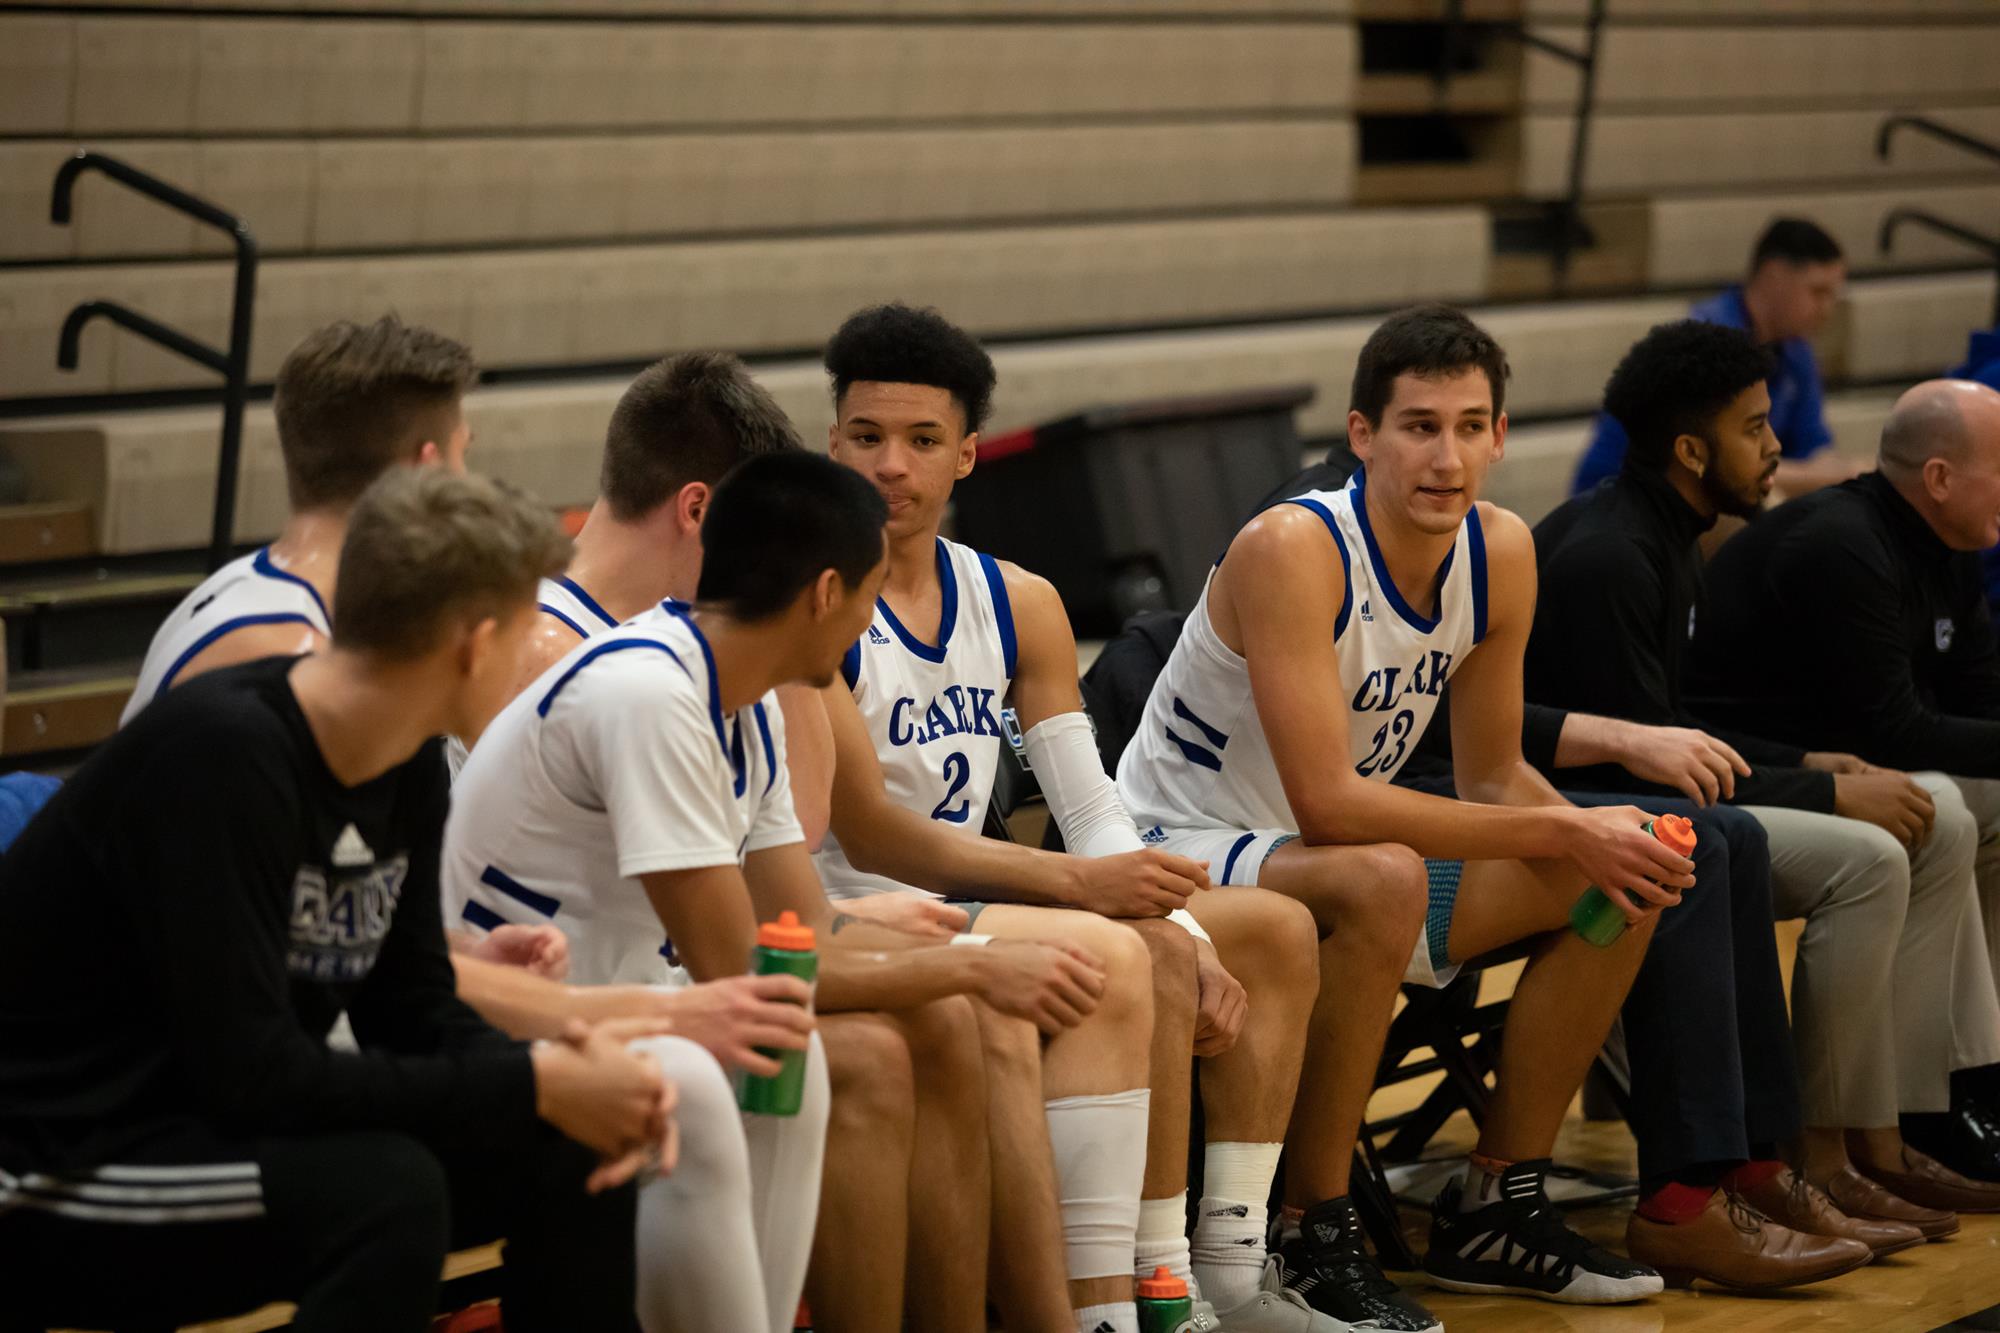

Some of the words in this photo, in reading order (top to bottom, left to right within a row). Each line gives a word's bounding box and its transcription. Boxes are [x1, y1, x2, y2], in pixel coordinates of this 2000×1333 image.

[1352, 650, 1452, 712] CLRK
[889, 684, 1000, 746] CARK
[1355, 709, 1414, 777] 23
[931, 752, 970, 823] 2
